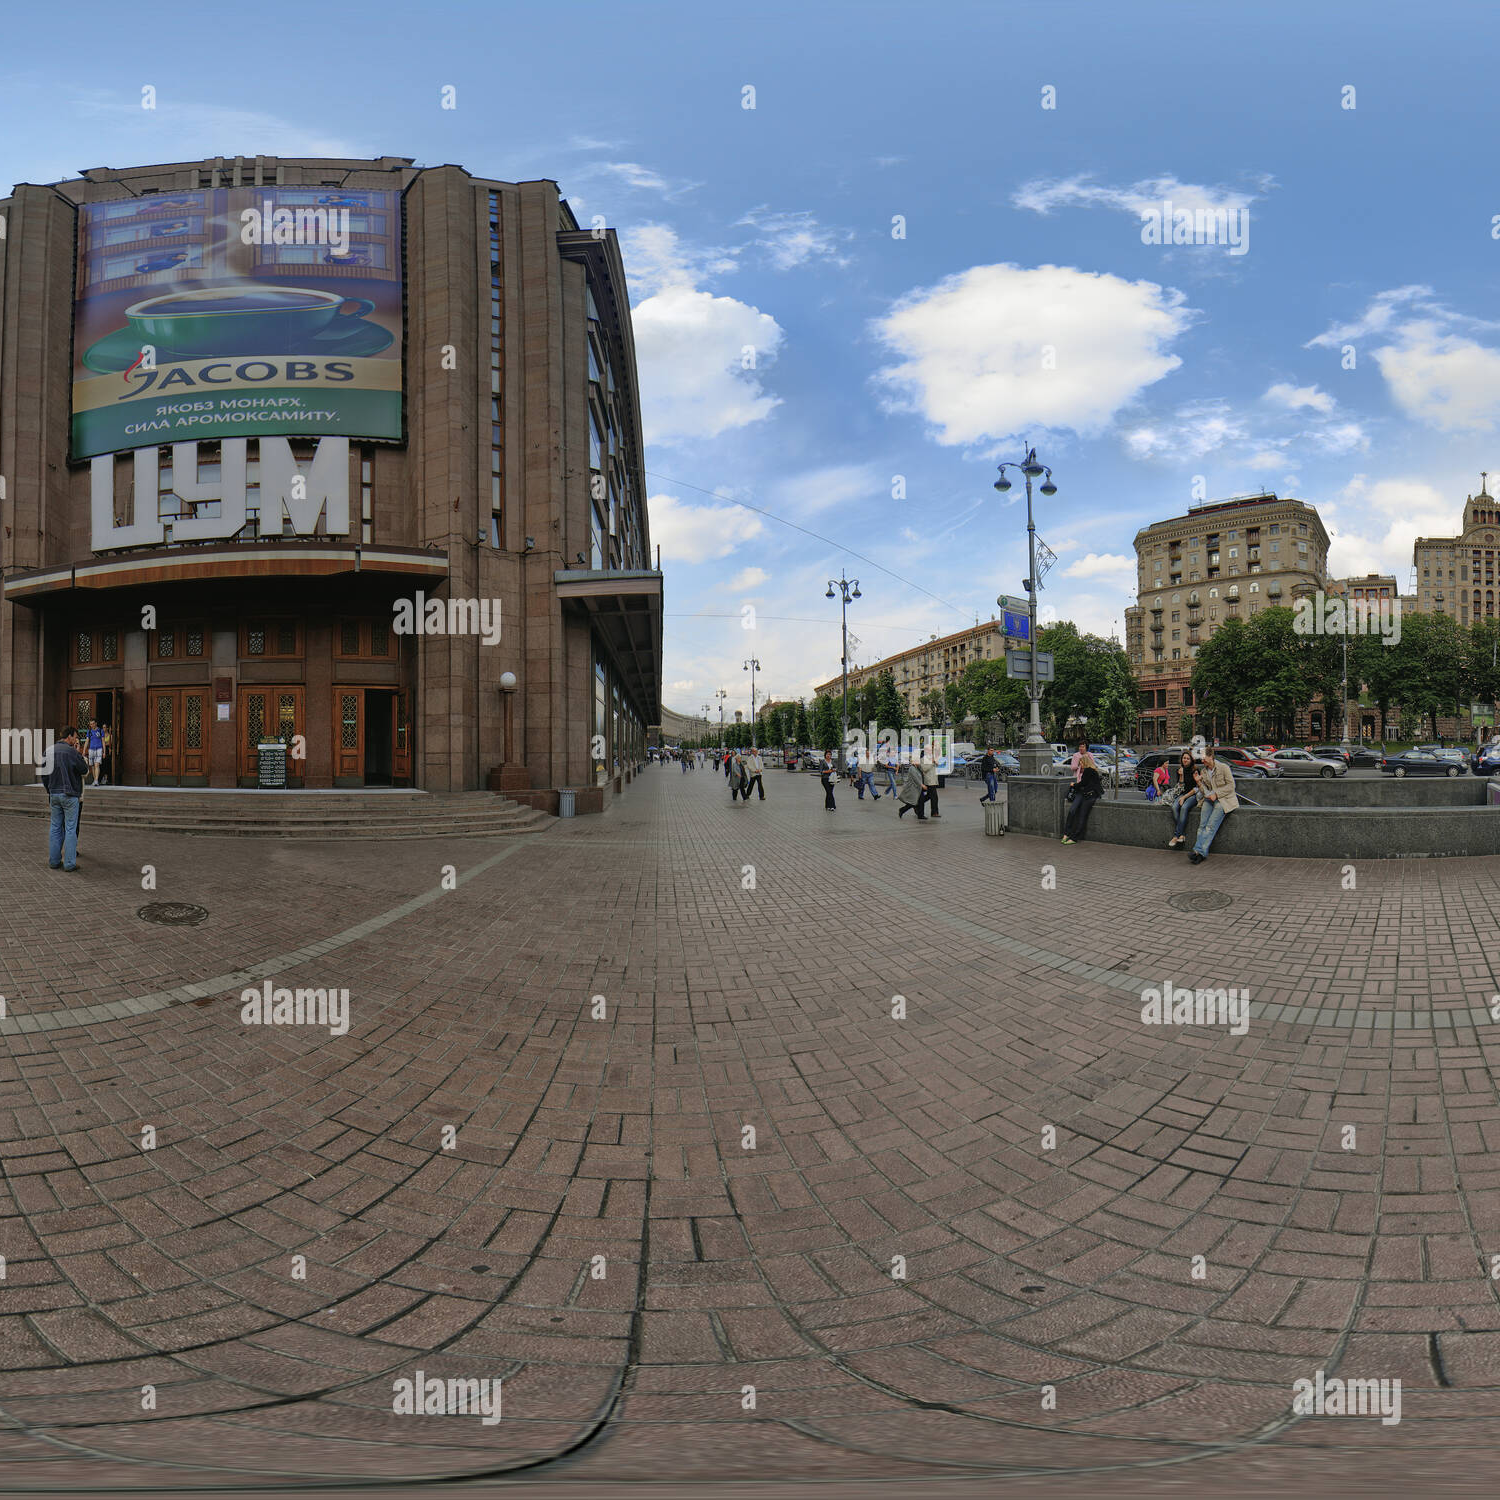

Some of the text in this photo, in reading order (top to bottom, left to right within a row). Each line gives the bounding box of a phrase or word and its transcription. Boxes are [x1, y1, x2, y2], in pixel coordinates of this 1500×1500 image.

[118, 351, 355, 400] JACOBS
[124, 410, 341, 435] СИЛА АРОМОКСАМИТУ.
[156, 398, 306, 416] ЯКОБЗ МОНАРХ.
[91, 437, 349, 550] ЦУМ
